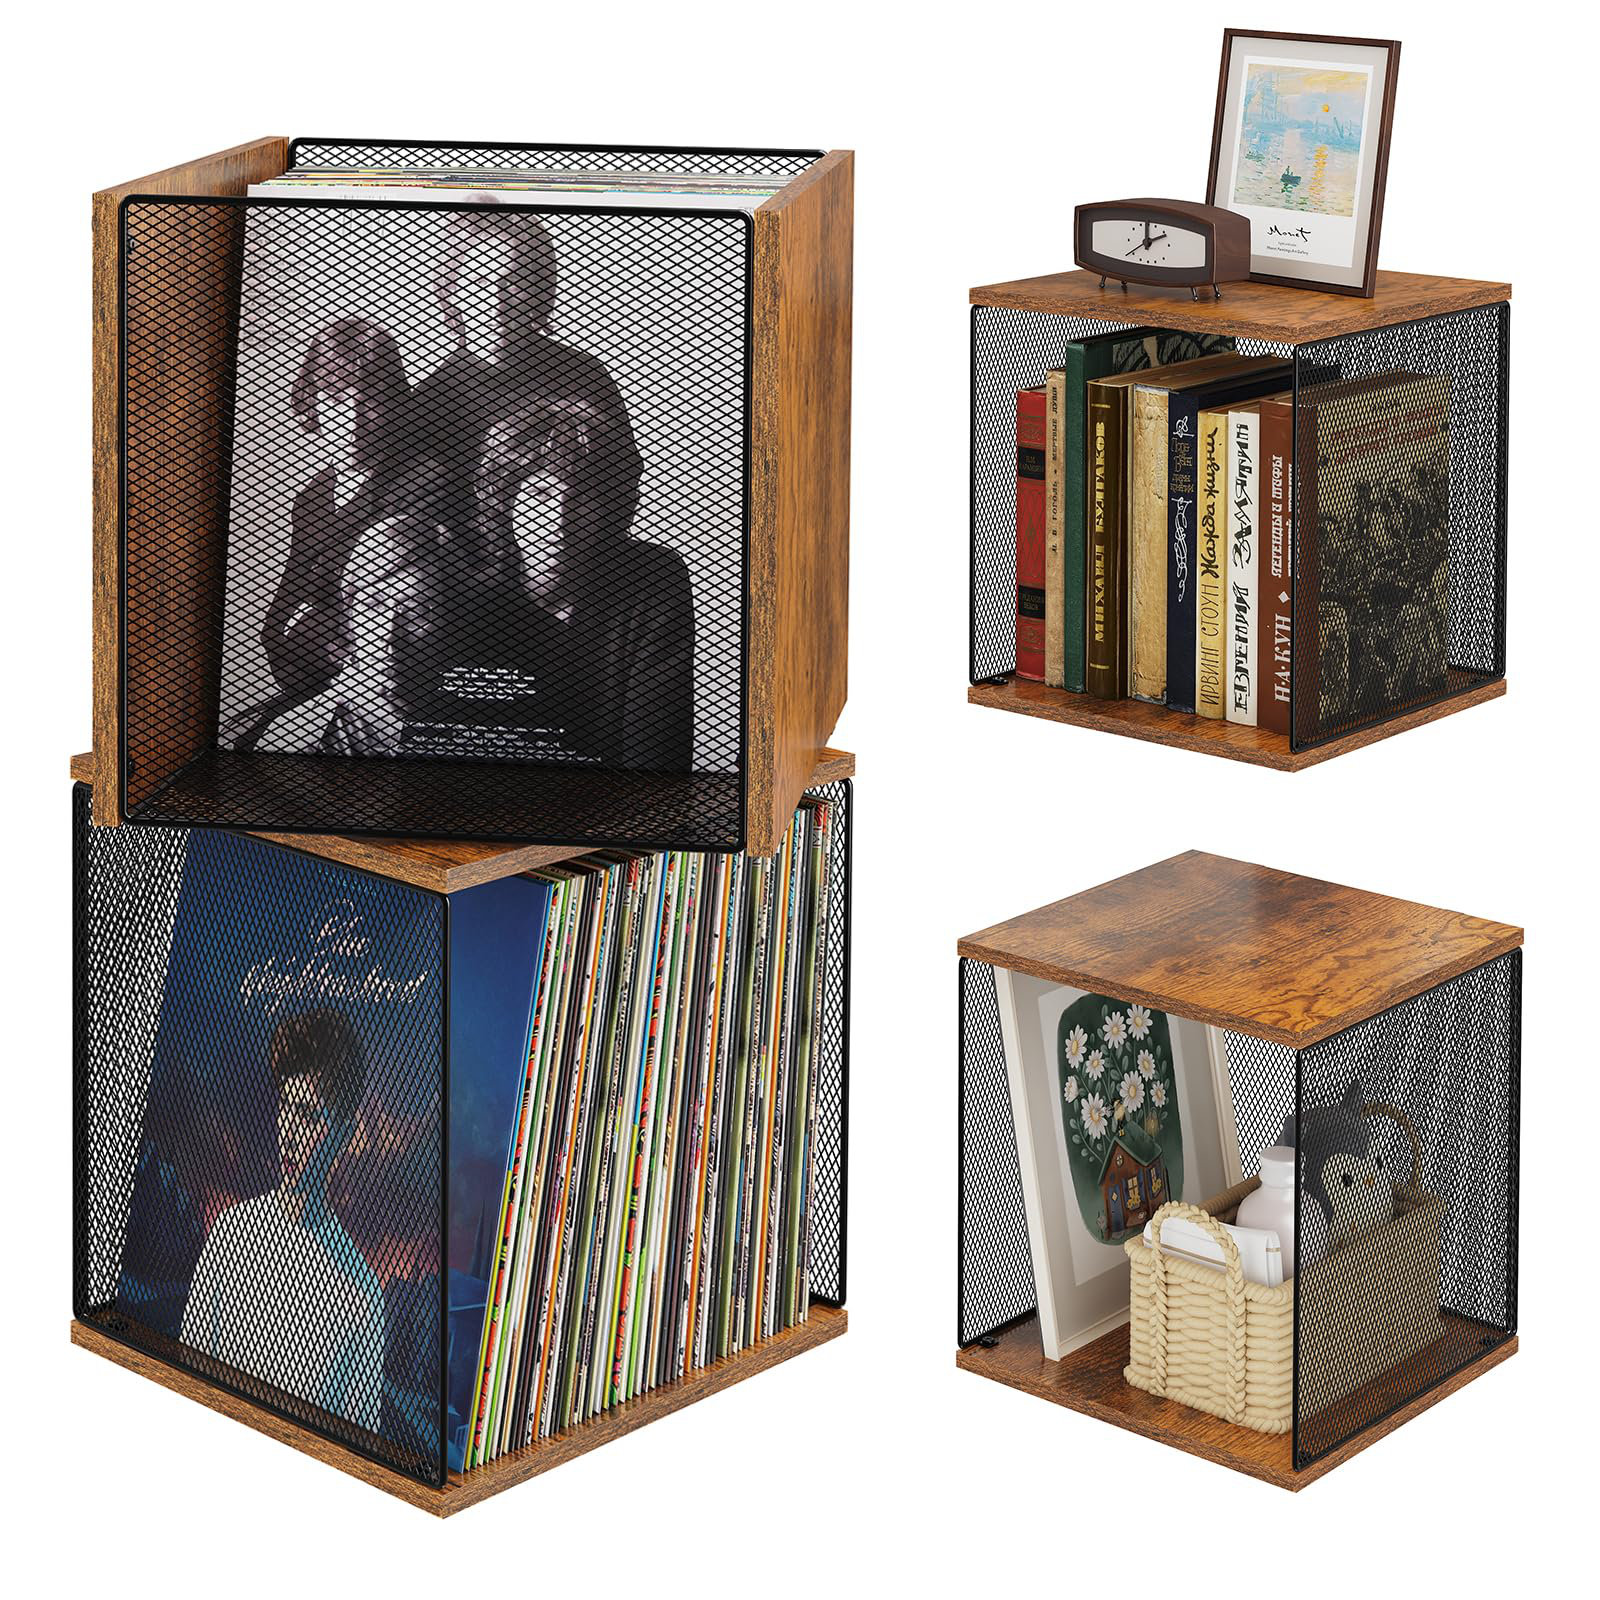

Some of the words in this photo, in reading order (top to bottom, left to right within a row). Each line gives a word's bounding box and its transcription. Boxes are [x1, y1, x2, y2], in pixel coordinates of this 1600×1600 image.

[1267, 225, 1311, 242] Monet
[1095, 422, 1105, 533] БУЛГАКОВ
[1204, 427, 1220, 499] жизни
[1232, 423, 1252, 569] ЗАМЯТИН
[1201, 501, 1220, 579] Жажда
[1095, 545, 1105, 642] МИХАИЛ
[1201, 583, 1219, 637] СТОУН
[1200, 641, 1219, 705] ИРВИНГ
[1233, 581, 1251, 714] ЕВГЕНИЙ
